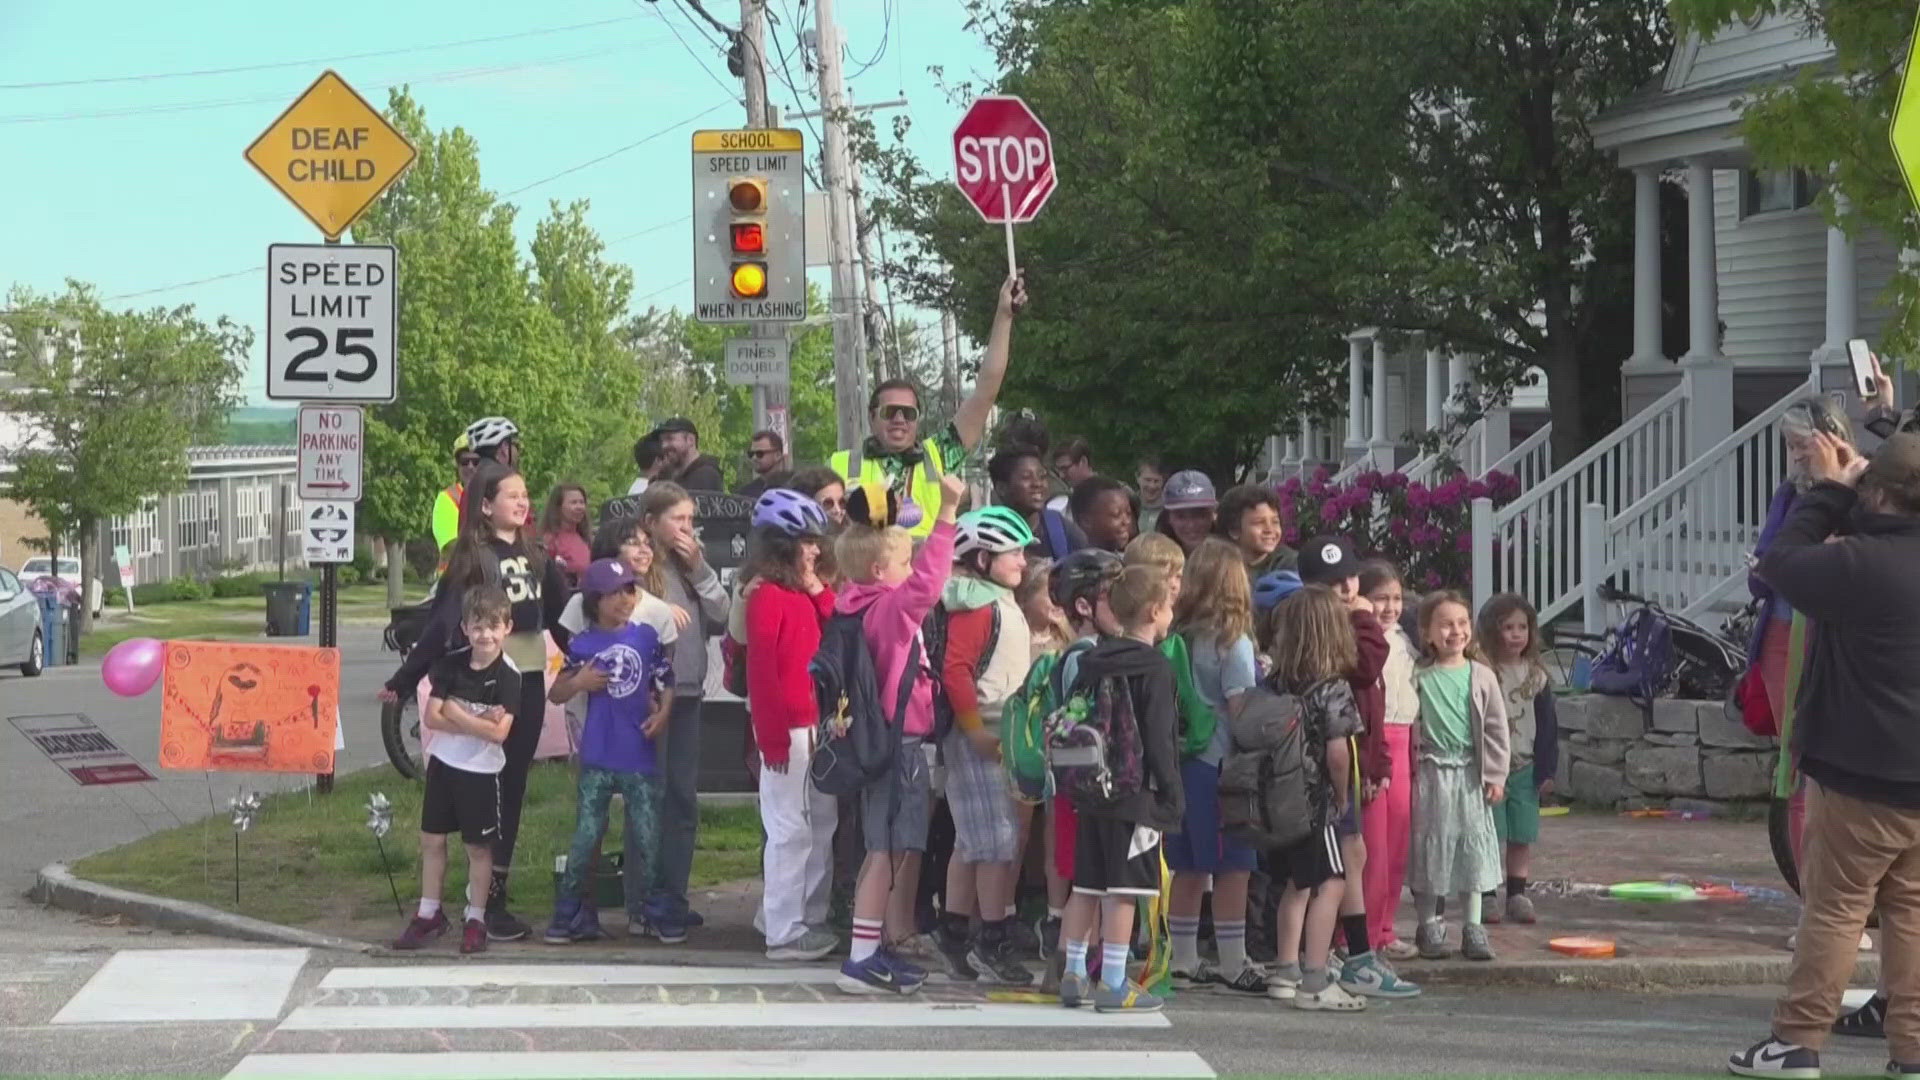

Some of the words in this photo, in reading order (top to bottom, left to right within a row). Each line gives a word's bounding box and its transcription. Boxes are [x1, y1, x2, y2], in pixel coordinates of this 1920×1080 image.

[292, 127, 369, 151] DEAF
[721, 133, 774, 148] SCHOOL
[710, 157, 750, 172] SPEED
[757, 155, 787, 171] LIMIT
[959, 135, 1046, 183] STOP
[288, 158, 376, 182] CHILD
[279, 262, 385, 286] SPEED
[291, 294, 372, 318] LIMIT
[698, 303, 735, 319] WHEN
[741, 301, 803, 318] FLASHING
[283, 326, 378, 383] 25
[737, 347, 776, 359] FINES
[730, 361, 784, 374] DOUBLE
[319, 413, 342, 429] NO
[303, 433, 357, 451] PARKING
[317, 454, 342, 465] ANY
[315, 468, 344, 482] TIME
